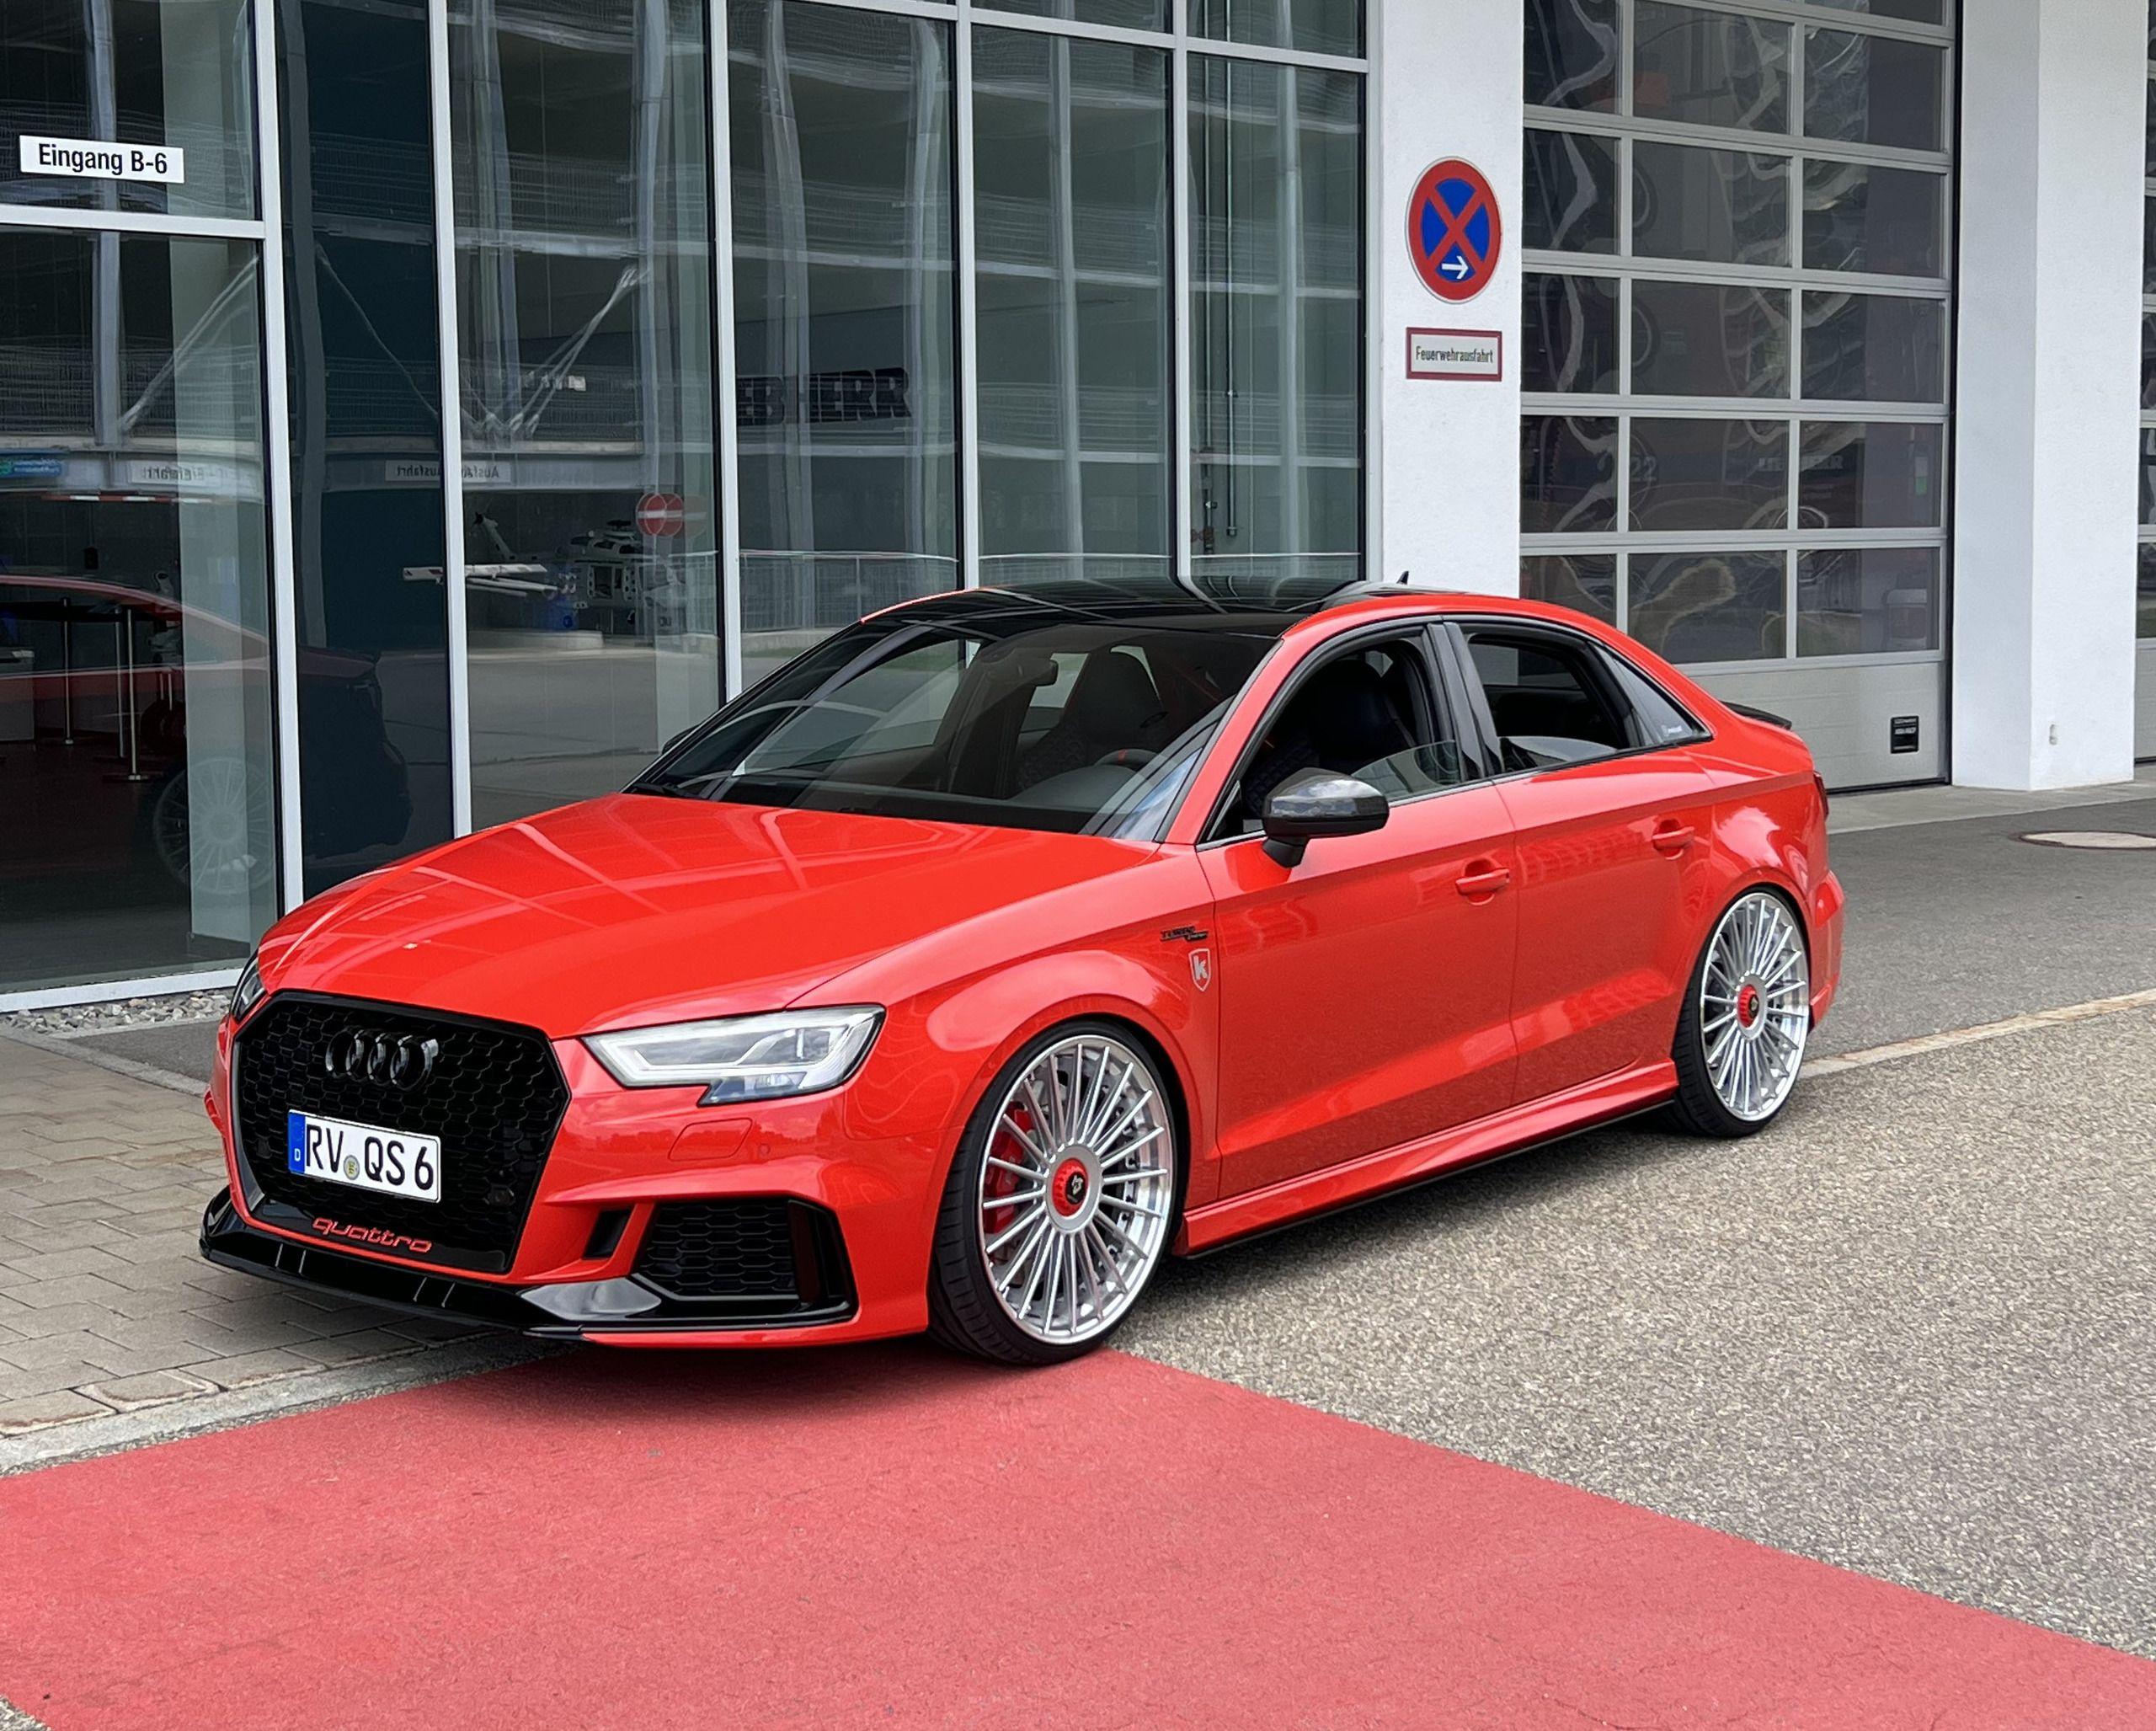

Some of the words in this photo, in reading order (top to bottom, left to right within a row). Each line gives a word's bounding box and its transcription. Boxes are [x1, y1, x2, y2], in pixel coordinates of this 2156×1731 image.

[38, 142, 124, 176] Eingang
[131, 150, 168, 174] B-6
[1415, 345, 1494, 363] Feuerwehrausfahrt
[293, 1147, 301, 1162] D
[306, 1123, 344, 1173] RV
[364, 1135, 406, 1187] QS
[414, 1146, 435, 1191] 6
[312, 1217, 433, 1253] quattro
